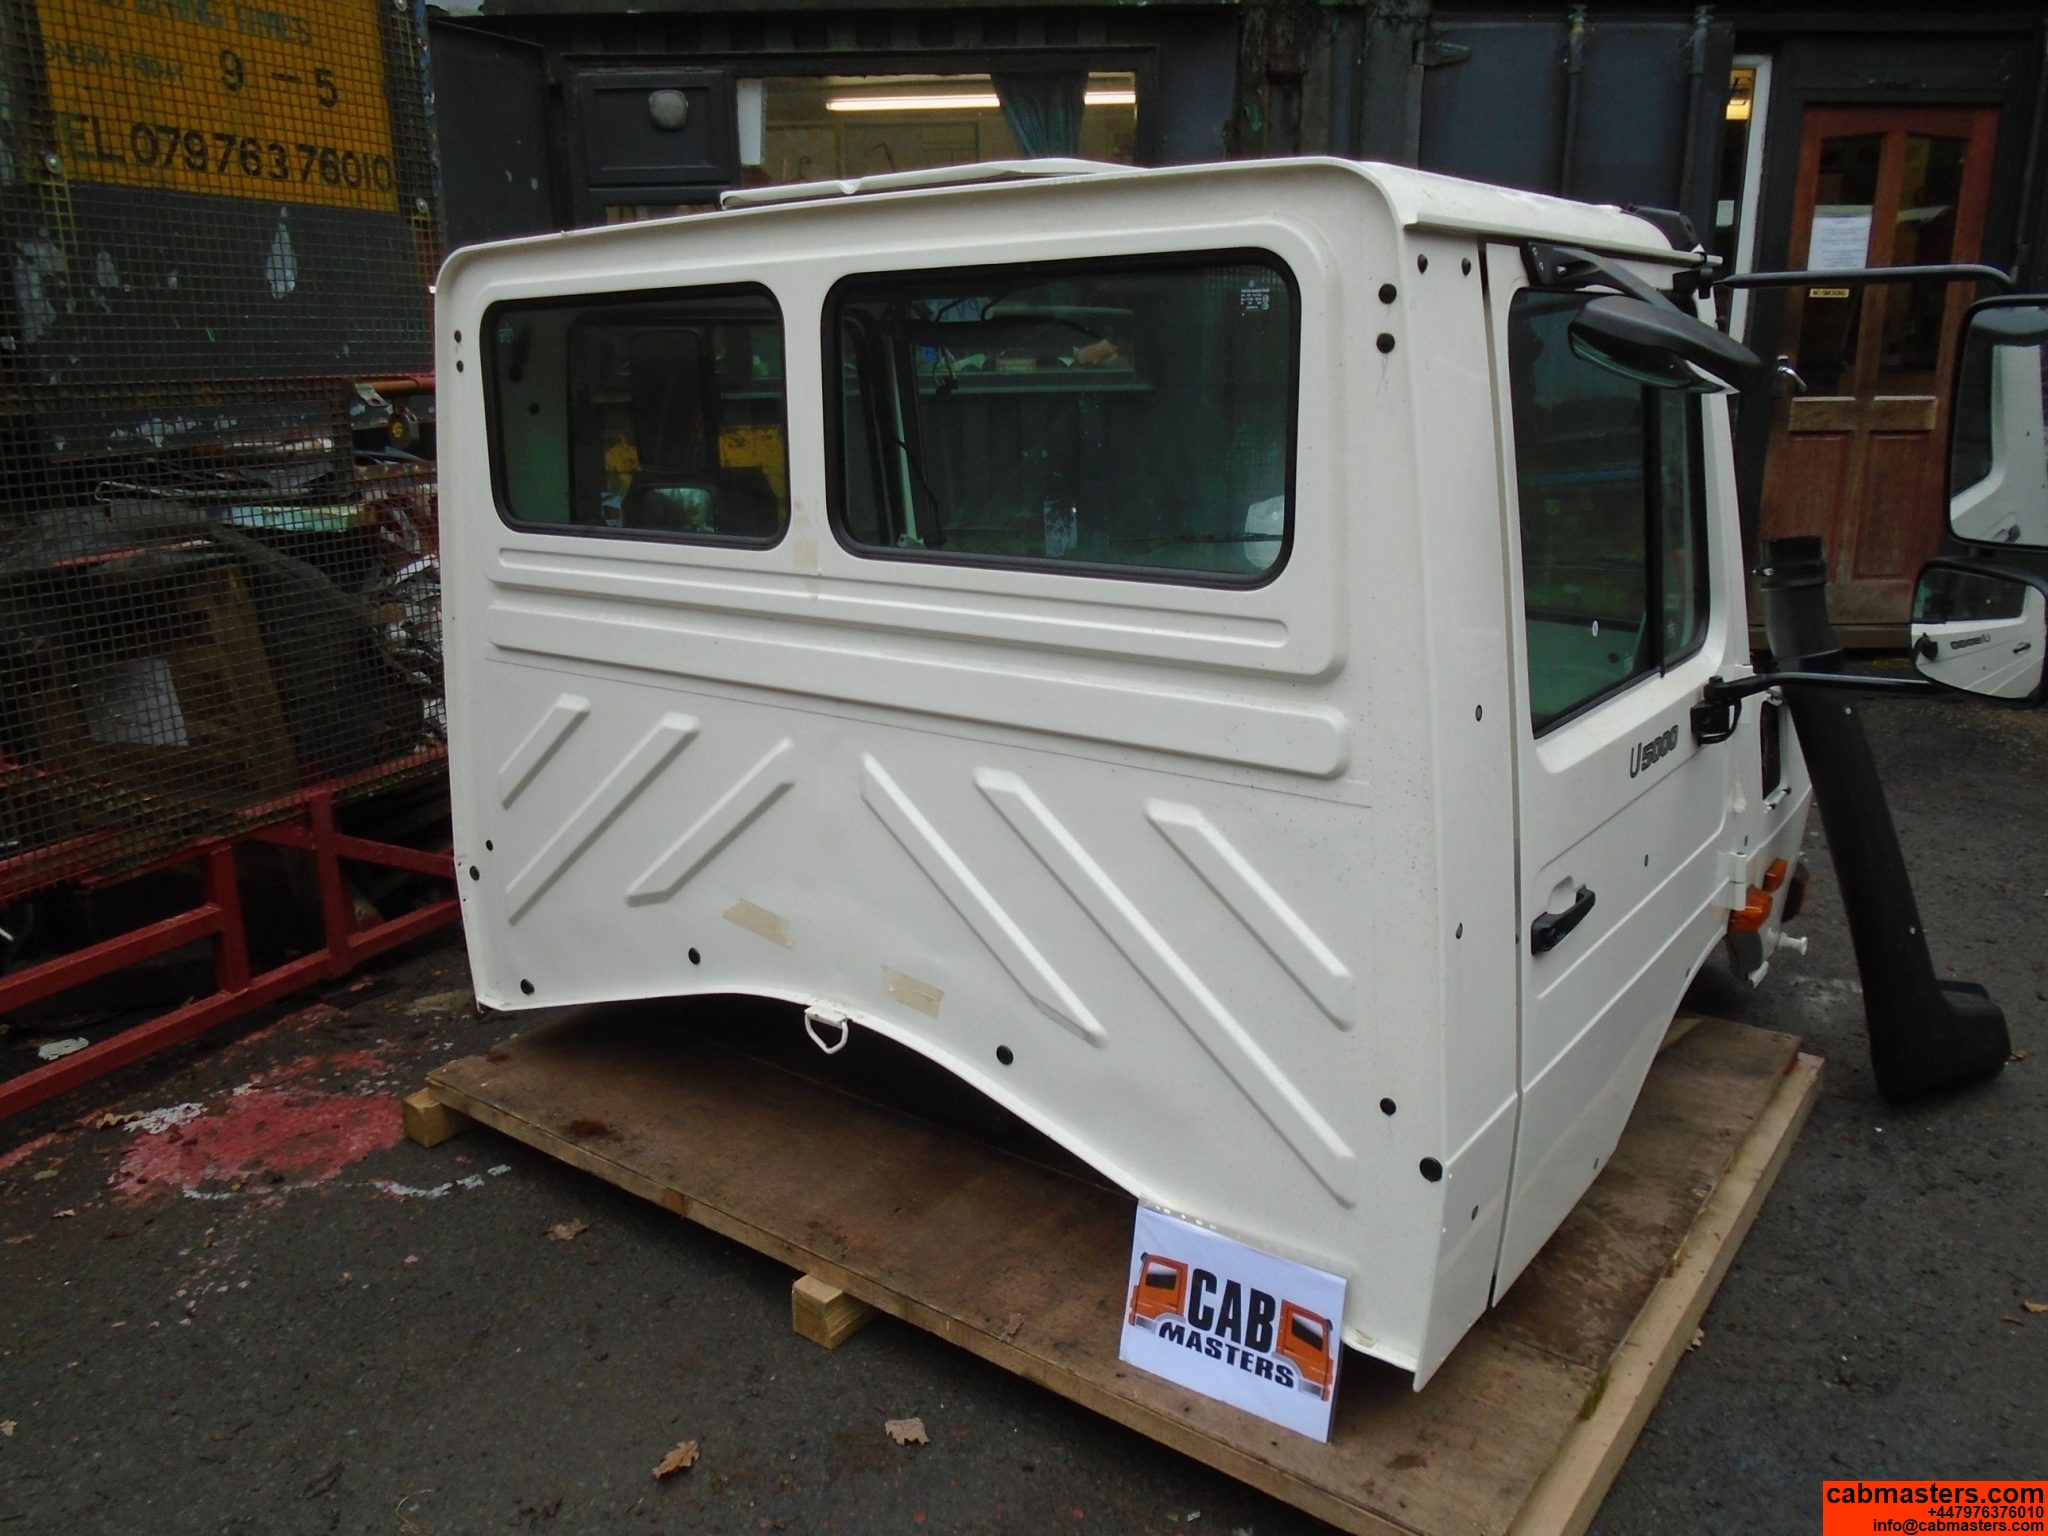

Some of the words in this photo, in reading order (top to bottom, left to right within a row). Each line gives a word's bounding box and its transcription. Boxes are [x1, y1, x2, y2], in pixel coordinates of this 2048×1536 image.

[219, 49, 246, 92] 9
[314, 68, 340, 108] 5
[1187, 1268, 1276, 1354] CAB
[1158, 1321, 1294, 1388] MASTERS
